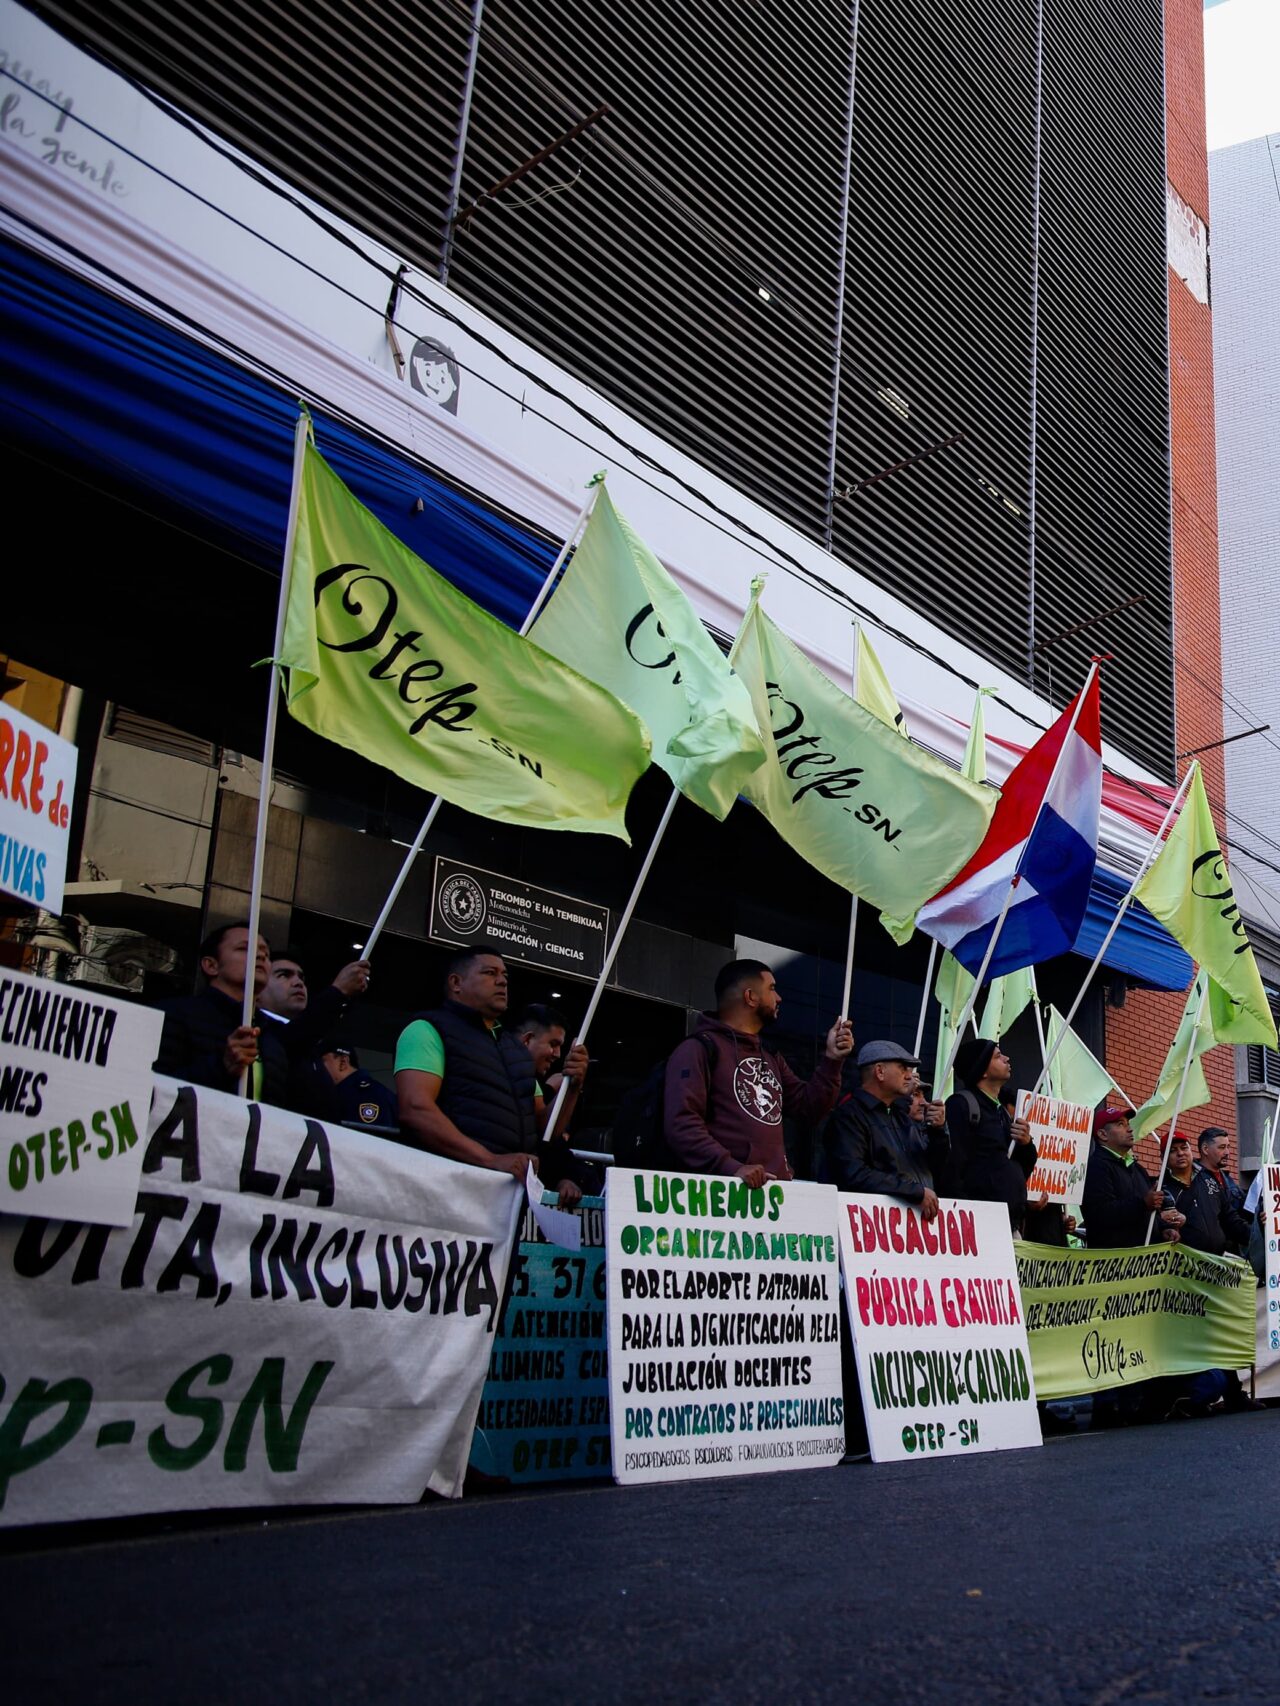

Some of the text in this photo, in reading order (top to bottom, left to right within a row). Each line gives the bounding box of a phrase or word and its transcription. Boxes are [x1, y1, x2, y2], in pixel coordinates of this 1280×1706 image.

[49, 779, 69, 829] de
[487, 914, 528, 933] Ministerio de
[542, 905, 555, 917] HA
[556, 909, 603, 931] TEMBIKUAA
[486, 926, 538, 948] EDUCACIÓN
[545, 942, 584, 961] CIENCIAS
[240, 1103, 335, 1207] LA
[634, 1174, 784, 1222] LUCHEMOS
[620, 1224, 836, 1263] ORGANIZADAMENTE
[846, 1201, 978, 1257] EDUCACIÓN
[250, 1213, 498, 1333] INCLUSIVA
[621, 1268, 660, 1300] POR
[756, 1272, 829, 1301] PATRONAL
[1072, 1259, 1091, 1286] DE
[1088, 1250, 1170, 1285] TRABAJADORES
[1168, 1251, 1186, 1276] DE
[855, 1268, 1021, 1328] PÚBLICA GRATUITA
[1025, 1288, 1209, 1332] DEL PARAGUAY SINDICATO NACIONAL
[621, 1312, 662, 1350] PARA
[665, 1313, 685, 1348] LA
[690, 1304, 804, 1347] DIGNIFICACIÓN
[622, 1352, 812, 1393] JUBILACIÓN DOCENTES
[869, 1350, 960, 1410] INCLUSIVA
[964, 1348, 1030, 1405] CALIDAD
[625, 1397, 843, 1439] POR CONTRATOS DE PROFESIONALES
